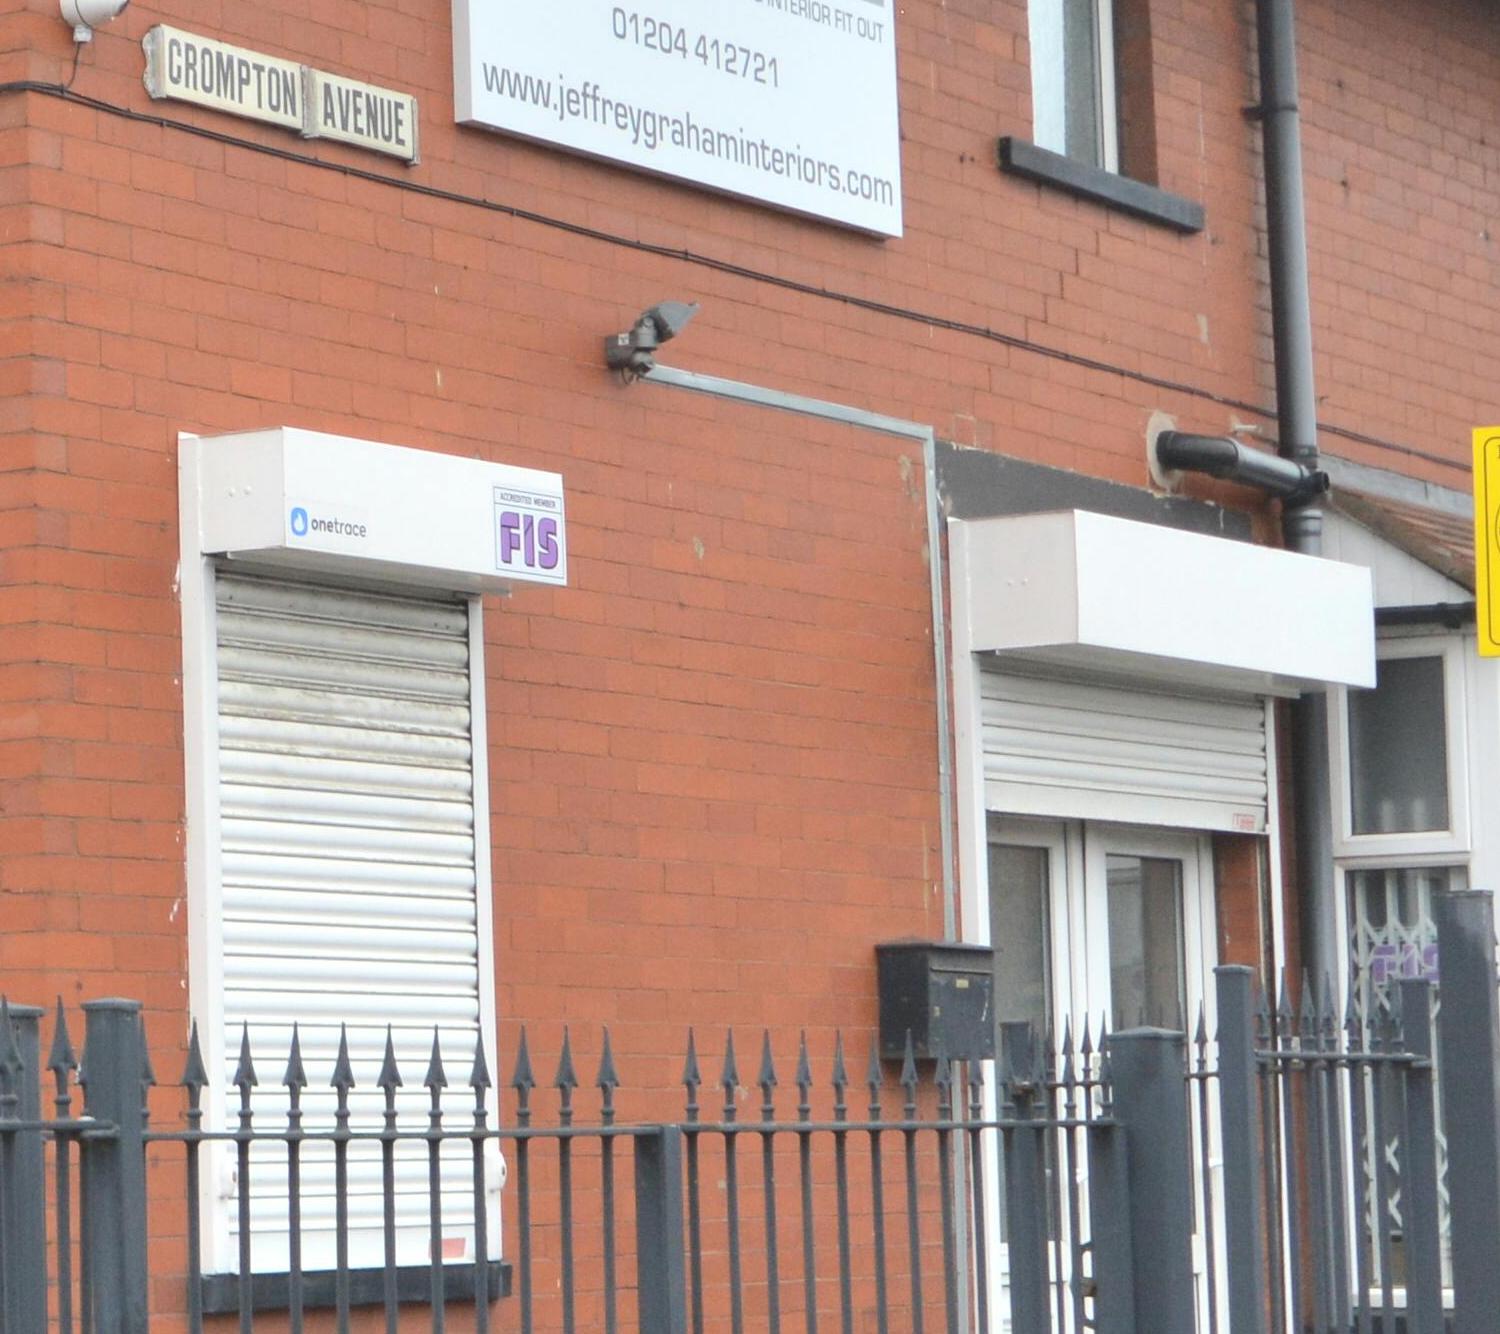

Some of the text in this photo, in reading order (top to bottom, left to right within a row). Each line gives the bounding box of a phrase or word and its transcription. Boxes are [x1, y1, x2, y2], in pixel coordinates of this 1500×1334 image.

[612, 6, 780, 88] 01204 412721
[835, 8, 853, 33] FIT
[857, 17, 884, 44] OUT
[168, 38, 406, 147] CROMPTON AVENUE
[482, 61, 894, 207] www.jeffreygrahaminteriors.com
[311, 516, 367, 538] onetrace
[500, 511, 559, 570] FIS
